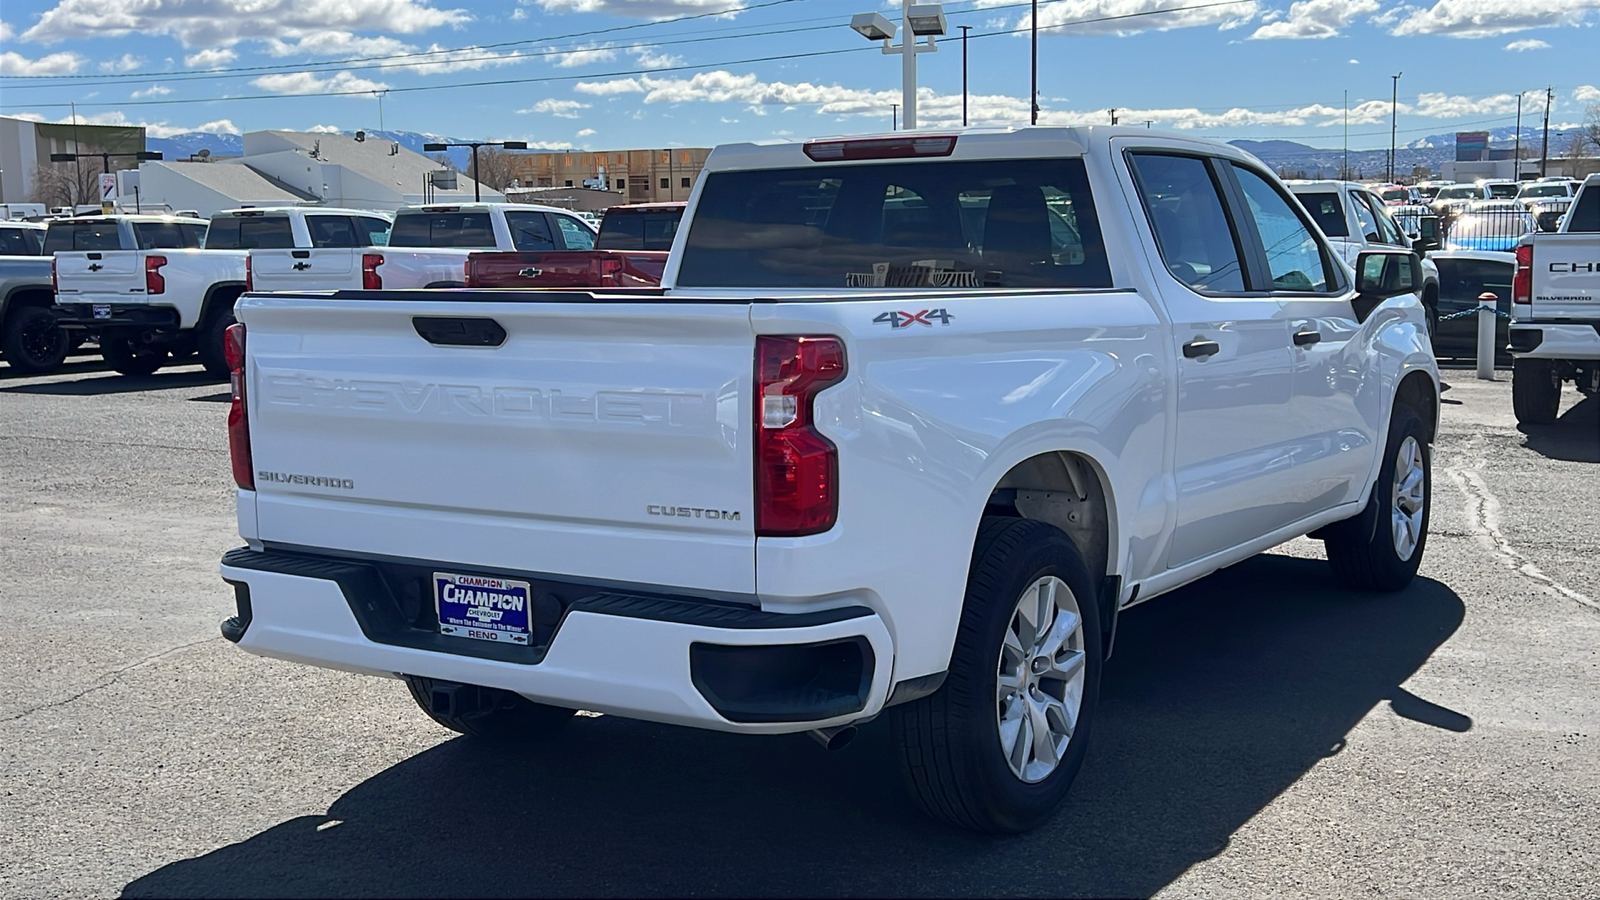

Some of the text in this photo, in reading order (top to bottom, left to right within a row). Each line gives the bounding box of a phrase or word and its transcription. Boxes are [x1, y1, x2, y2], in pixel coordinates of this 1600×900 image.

[1549, 262, 1600, 273] CH
[264, 374, 705, 427] CHEVROLET
[257, 470, 354, 490] SILVERADO
[646, 504, 742, 521] CUSTOM
[458, 576, 503, 588] CHAMPION
[469, 609, 501, 619] CHEVROLET
[468, 630, 498, 640] RENO
